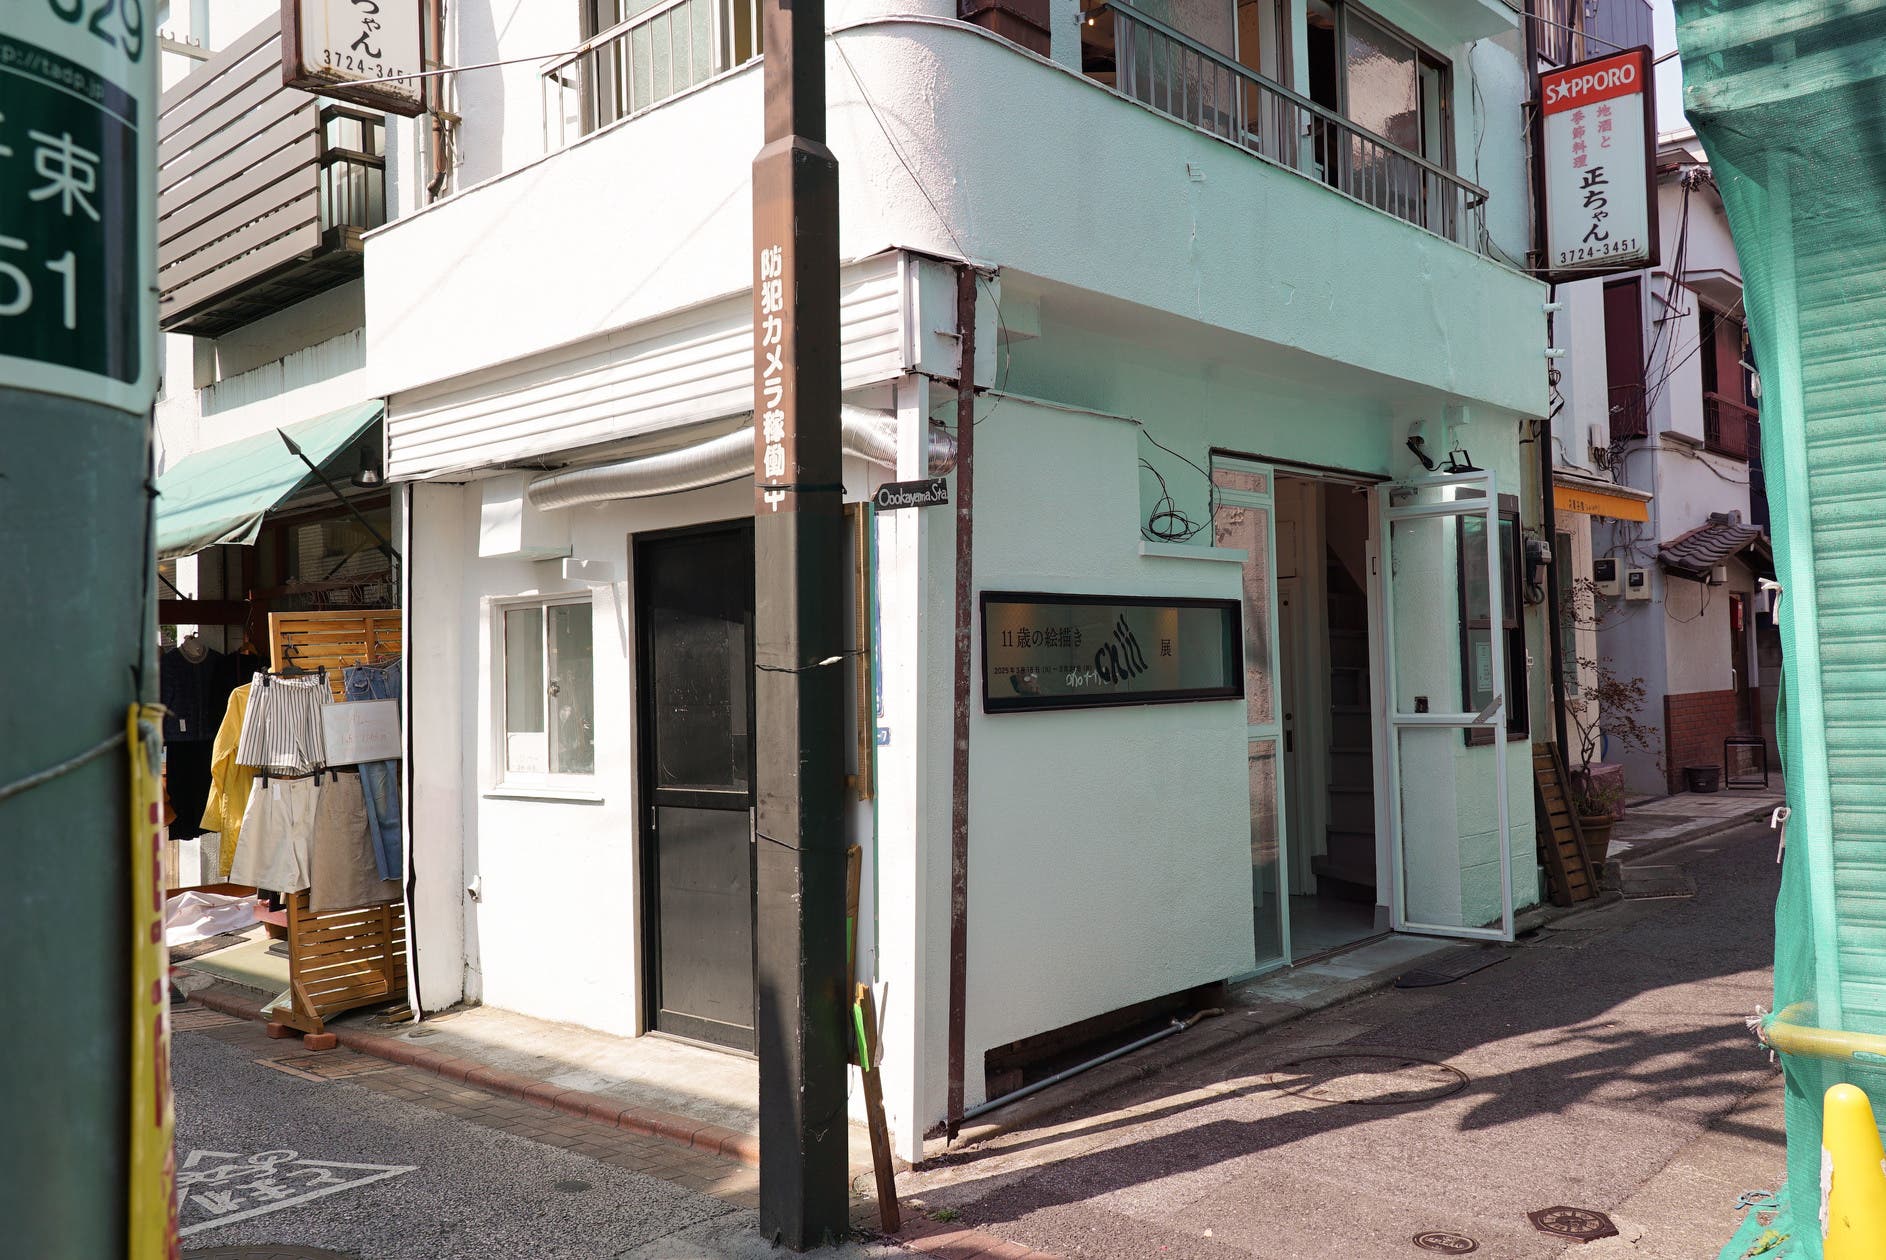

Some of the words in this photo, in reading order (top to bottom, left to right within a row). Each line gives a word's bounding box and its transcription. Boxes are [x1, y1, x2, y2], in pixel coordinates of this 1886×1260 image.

[324, 49, 413, 87] 3724-3451
[1571, 110, 1588, 169] 季節料理
[1597, 104, 1613, 148] 地酒と
[1579, 166, 1609, 244] 正ちゃん
[1560, 238, 1636, 264] 3724-3451
[760, 244, 786, 512] 防犯カメラ稼働中
[1160, 638, 1172, 657] 展
